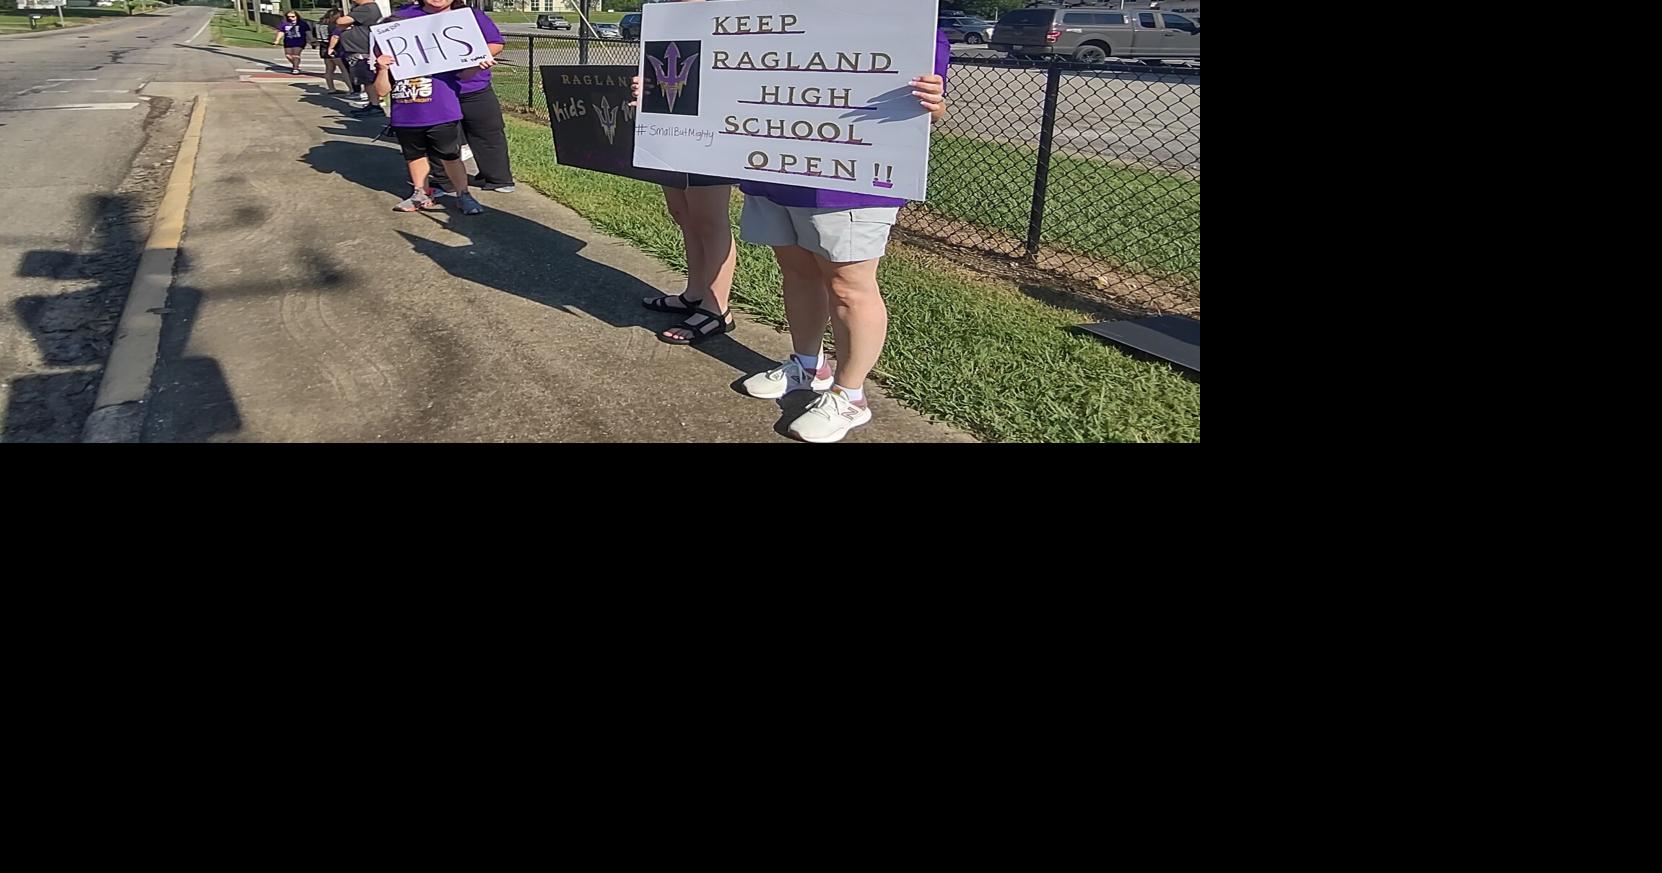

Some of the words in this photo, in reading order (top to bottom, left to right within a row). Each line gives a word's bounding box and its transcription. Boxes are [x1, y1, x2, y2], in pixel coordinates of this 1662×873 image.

[713, 14, 798, 33] KEEP
[386, 26, 473, 66] RHS
[713, 51, 892, 71] RAGLAND
[561, 74, 633, 88] RAGLAN
[761, 85, 852, 107] HIGH
[724, 116, 863, 144] SCHOOL
[747, 151, 857, 179] OPEN
